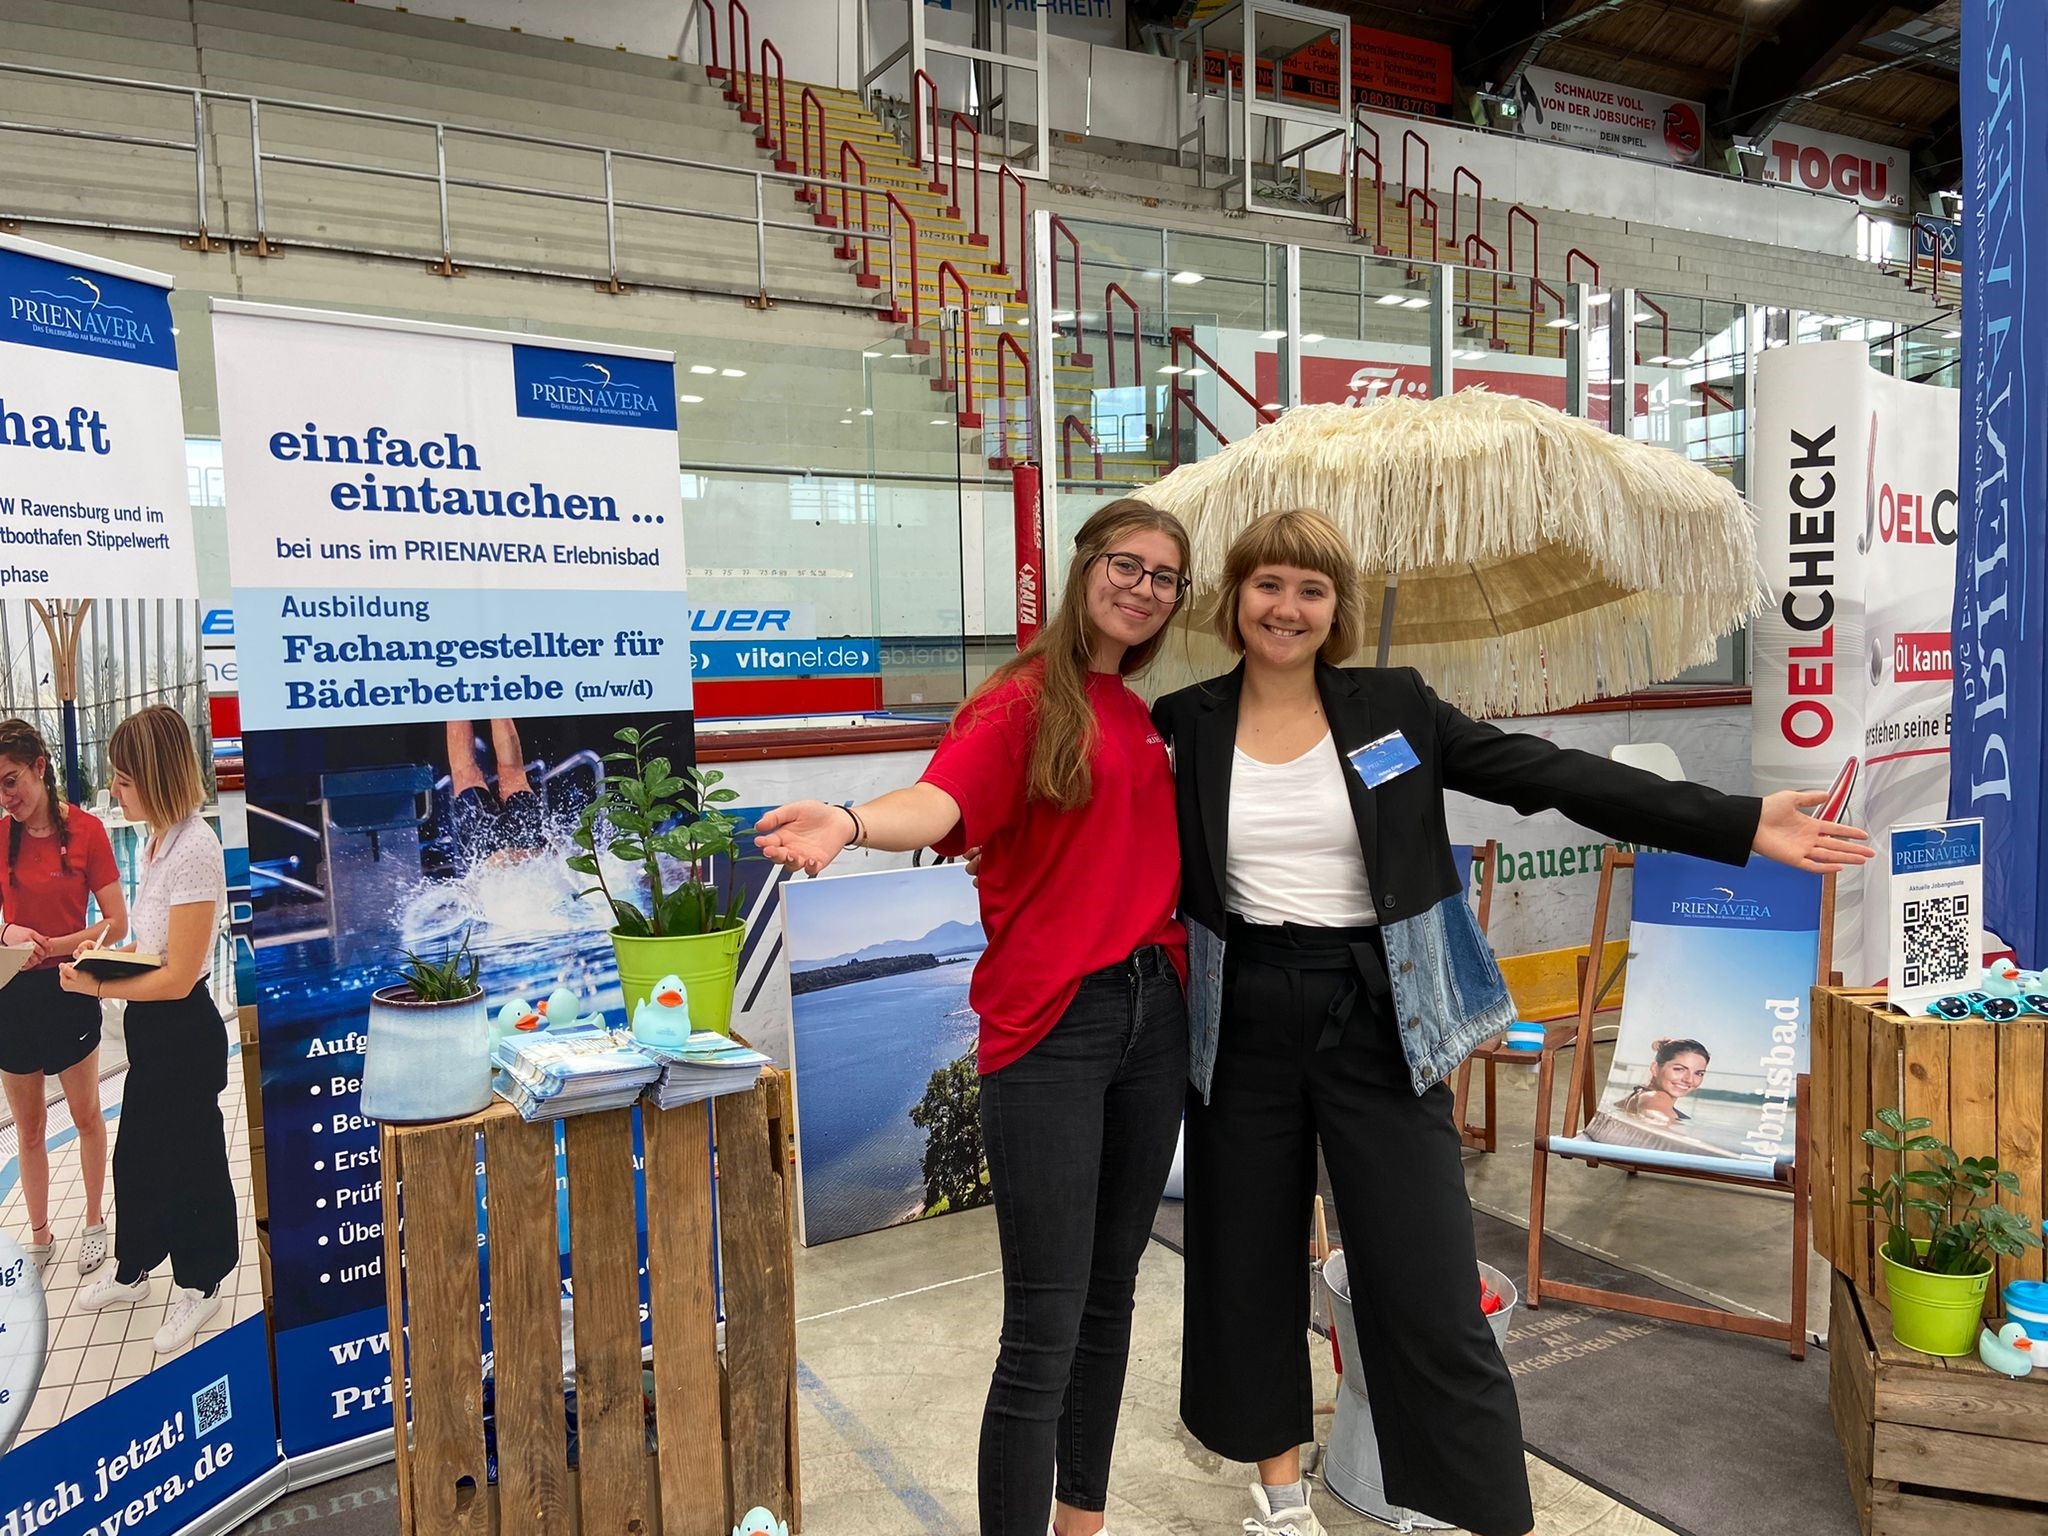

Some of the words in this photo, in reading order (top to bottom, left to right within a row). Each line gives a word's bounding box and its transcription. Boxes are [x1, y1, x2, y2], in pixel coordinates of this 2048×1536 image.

[1555, 82, 1613, 105] SCHNAUZE
[1617, 96, 1644, 111] VOLL
[1541, 97, 1564, 112] VON
[1569, 104, 1590, 117] DER
[1593, 109, 1656, 131] JOBSUCHE?
[1600, 132, 1620, 144] DEIN
[1622, 135, 1647, 148] SPIEL.
[1772, 140, 1887, 201] TOGU
[9, 296, 155, 345] PRIENAVERA
[531, 383, 659, 412] PRIENAVERA
[269, 422, 481, 471] einfach
[21, 498, 110, 523] Ravensburg
[114, 504, 142, 523] und
[146, 505, 164, 523] im
[330, 473, 620, 522] eintauchen
[1879, 483, 1958, 546] OELC
[0, 527, 82, 547] tboothafen
[86, 530, 170, 551] Stippelwerft
[277, 537, 311, 559] bei
[321, 542, 361, 560] uns
[369, 538, 397, 561] im
[405, 540, 547, 564] PRIENAVERA
[554, 544, 660, 567] Erlebnisbad
[0, 566, 49, 587] phase
[1781, 425, 1836, 748] OELCHECK
[281, 594, 430, 622] Ausbildung
[688, 609, 791, 632] UER
[282, 632, 605, 667] Fachangestellter
[614, 630, 665, 657] für
[735, 647, 860, 669] vitanet.de
[1896, 637, 1909, 672] Öl
[1913, 644, 1952, 672] kann
[285, 674, 564, 710] Bäderbetriebe
[575, 679, 654, 702] (m/w/d)
[1904, 715, 1939, 739] seine
[1896, 844, 1976, 866] PRIENAVERA
[1672, 901, 1771, 917] PRIENAVERA
[340, 1255, 381, 1283] und
[1541, 1331, 1577, 1348] AM
[0, 1481, 84, 1536] dich
[94, 1411, 185, 1502] jetzt!
